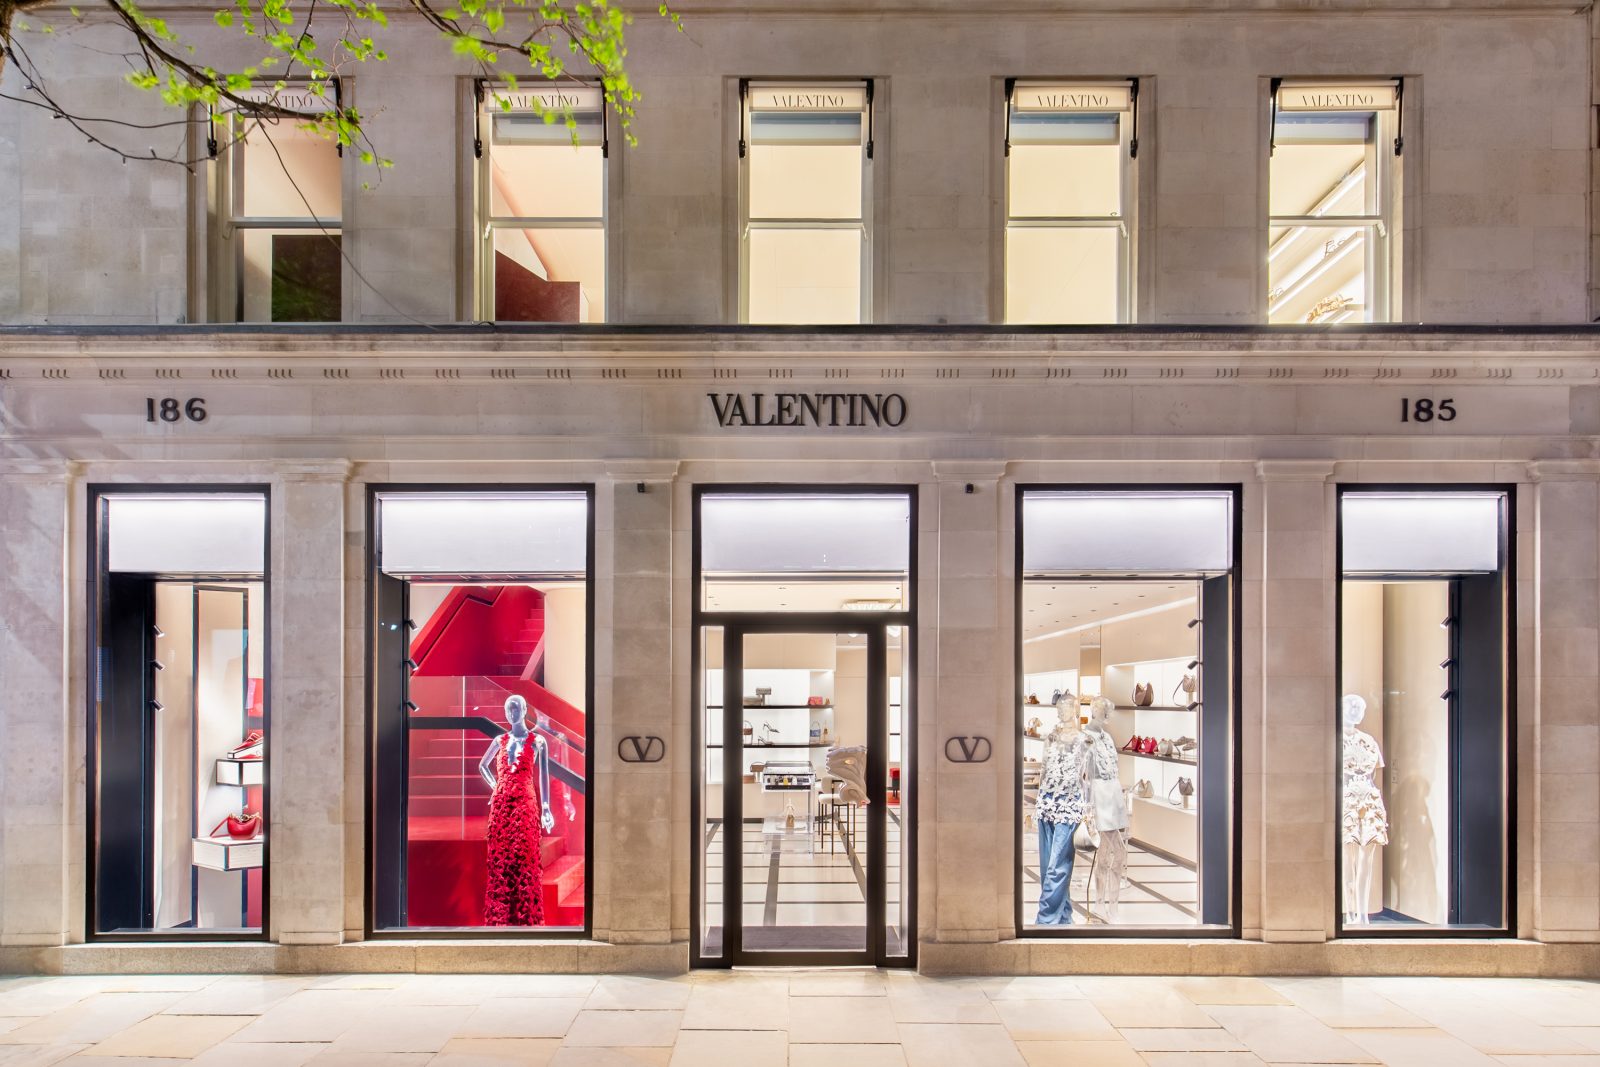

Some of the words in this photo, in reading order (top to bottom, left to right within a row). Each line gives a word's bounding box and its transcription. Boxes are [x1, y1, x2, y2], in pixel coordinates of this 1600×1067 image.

[773, 95, 844, 108] VALENTINO
[1037, 95, 1109, 108] VALENTINO
[1302, 94, 1374, 107] VALENTINO
[146, 397, 207, 422] 186
[707, 393, 907, 427] VALENTINO
[1400, 398, 1457, 422] 185
